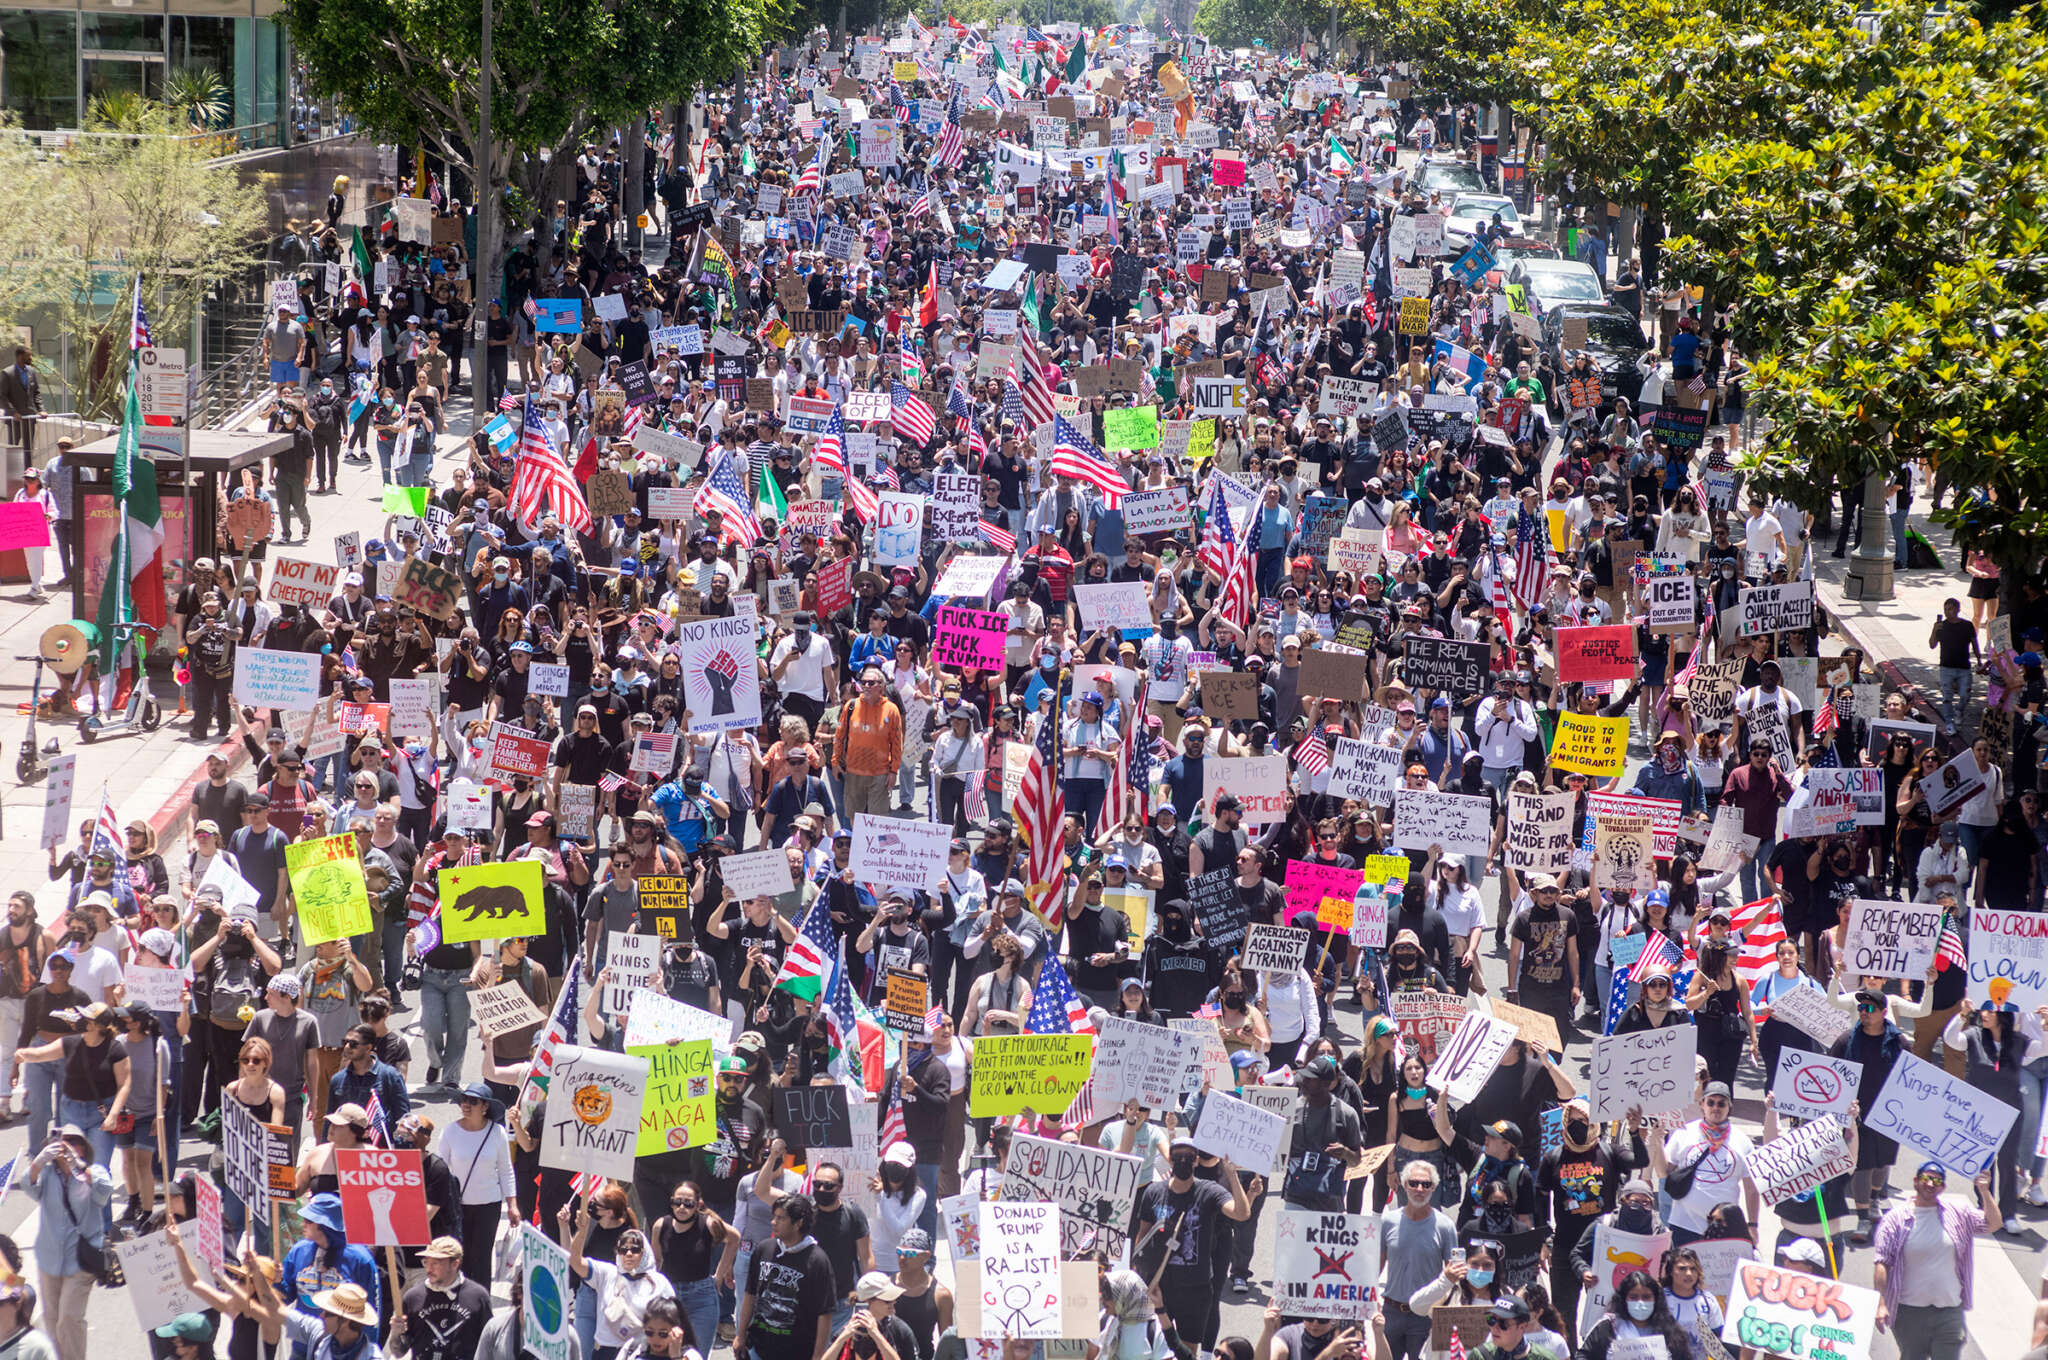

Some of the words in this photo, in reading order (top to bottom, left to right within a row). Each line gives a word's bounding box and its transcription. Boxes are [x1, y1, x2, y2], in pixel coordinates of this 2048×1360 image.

[1035, 118, 1051, 126] ALL
[1036, 133, 1063, 141] PEOPLE
[1178, 251, 1198, 260] NOW!
[1401, 322, 1426, 331] WAR!
[159, 362, 182, 370] Metro
[625, 365, 636, 374] NO
[718, 366, 742, 375] KINGS
[623, 371, 645, 383] KINGS
[629, 380, 645, 390] JUST
[141, 384, 152, 392] 18
[141, 394, 152, 402] 20
[936, 475, 981, 495] ELECT
[1124, 491, 1162, 504] DIGNITY
[878, 500, 919, 530] NO
[1131, 508, 1144, 516] LA
[1146, 503, 1173, 513] RAZA
[1124, 517, 1167, 530] ESTAMOS
[1333, 540, 1351, 550] FOR
[1352, 542, 1378, 553] THOSE
[1335, 550, 1365, 560] WITHOUT
[1652, 551, 1670, 559] HAS
[1339, 558, 1369, 570] VOICE
[275, 559, 311, 580] NOT
[313, 566, 339, 587] MY
[269, 581, 332, 610] CHEETOH!
[1653, 582, 1691, 602] ICE:
[942, 609, 977, 629] FUCK
[978, 613, 1009, 633] ICE
[1761, 613, 1811, 633] EQUALITY
[682, 625, 705, 642] NO
[710, 619, 750, 639] KINGS
[940, 631, 981, 654] FUCK
[1407, 639, 1433, 657] THE
[1438, 642, 1476, 661] REAL
[1582, 639, 1621, 648] JUSTICE
[1407, 656, 1463, 676] CRIMINAL
[1466, 664, 1479, 678] IS
[1410, 673, 1424, 686] IN
[1427, 674, 1485, 695] OFFICE!
[1695, 678, 1721, 694] THE
[1689, 690, 1733, 708] GRIND
[1561, 720, 1596, 734] PROUD
[1602, 727, 1615, 735] TO
[499, 738, 519, 750] KEEP
[1572, 734, 1595, 744] LIVE
[495, 748, 532, 763] FAMILIES
[1338, 740, 1401, 766] IMMIGRANTS
[1571, 744, 1597, 754] CITY
[1603, 746, 1617, 755] OF
[494, 756, 537, 772] TOGETHER!
[1552, 752, 1616, 768] IMMIGRANTS
[1332, 766, 1386, 787] AMERICA
[1832, 769, 1883, 793] SASHAY
[1514, 795, 1544, 810] THIS
[1526, 806, 1565, 823] LAND
[1510, 820, 1540, 836] WAS
[1510, 832, 1545, 849] MADE
[1549, 832, 1569, 849] FOR
[1510, 849, 1534, 867] YOU
[1551, 851, 1570, 868] ME
[640, 877, 653, 890] ICE
[655, 877, 673, 890] OUT
[877, 870, 927, 887] TYRANNY!
[662, 894, 686, 907] HOME
[1357, 904, 1386, 925] CHINGA
[1860, 907, 1941, 938] REMEMBER
[1974, 913, 2000, 933] NO
[622, 936, 639, 949] NO
[1252, 926, 1309, 942] AMERICANS
[1354, 928, 1384, 946] MIGRA
[1874, 932, 1900, 948] YOUR
[1248, 937, 1303, 956] AGAINST
[610, 953, 650, 970] KINGS
[1248, 950, 1304, 972] TYRANNY
[1856, 947, 1910, 974] OATH
[626, 974, 650, 988] THE
[1970, 958, 2047, 991] CLOWN
[477, 989, 508, 1005] SMALL
[1398, 993, 1426, 1003] MAIN
[1429, 994, 1463, 1005] EVENT
[476, 997, 529, 1021] DICKTATOR
[1394, 1003, 1419, 1014] BATTLE
[489, 1011, 531, 1033] ENERGY
[1105, 1016, 1127, 1031] CITY
[977, 1039, 998, 1055] ALL
[1008, 1038, 1025, 1053] MY
[1025, 1037, 1069, 1053] OUTRAGE
[1098, 1037, 1126, 1049] CHINGA
[1626, 1030, 1677, 1049] TRUMP
[974, 1055, 998, 1070] CANT
[1000, 1053, 1014, 1068] FIT
[1028, 1053, 1047, 1066] ONE
[1630, 1055, 1673, 1075] ICE
[1781, 1052, 1803, 1073] NO
[1830, 1059, 1860, 1088] KINGS
[555, 1054, 639, 1096] Tangerine
[973, 1069, 990, 1082] PUT
[992, 1069, 1019, 1081] DOWN
[1020, 1069, 1037, 1080] THE
[1896, 1053, 1939, 1101] Kings
[1942, 1080, 1972, 1111] have
[651, 1082, 684, 1105] TU
[1638, 1079, 1676, 1101] GOP
[785, 1089, 841, 1122] FUCK
[1246, 1089, 1290, 1111] Trump
[1773, 1101, 1797, 1112] LAND
[223, 1093, 264, 1155] POWER
[639, 1104, 707, 1133] MAGA
[1238, 1118, 1266, 1137] THE
[1966, 1111, 2004, 1147] Nixed
[552, 1120, 635, 1155] TYRANT
[1201, 1121, 1272, 1162] CATHETER
[1872, 1098, 1932, 1149] Since
[1929, 1127, 1988, 1177] 1776
[224, 1124, 240, 1162] TO
[241, 1141, 264, 1187] THE
[359, 1152, 398, 1169] NO
[340, 1170, 421, 1187] KINGS
[1012, 1141, 1142, 1200] SOLIDARITY
[226, 1157, 266, 1221] PEOPLE
[1761, 1168, 1822, 1207] EPSTEIN
[1818, 1154, 1855, 1181] FILES
[993, 1205, 1047, 1221] DONALD
[997, 1222, 1044, 1236] TRUMP
[1320, 1215, 1346, 1230] NO
[1305, 1226, 1360, 1247] KINGS
[1007, 1242, 1019, 1255] IS
[1287, 1282, 1308, 1298] IN
[1313, 1283, 1378, 1302] AMERICA
[1741, 1265, 1855, 1323] FUCK
[1737, 1304, 1809, 1355] ice!
